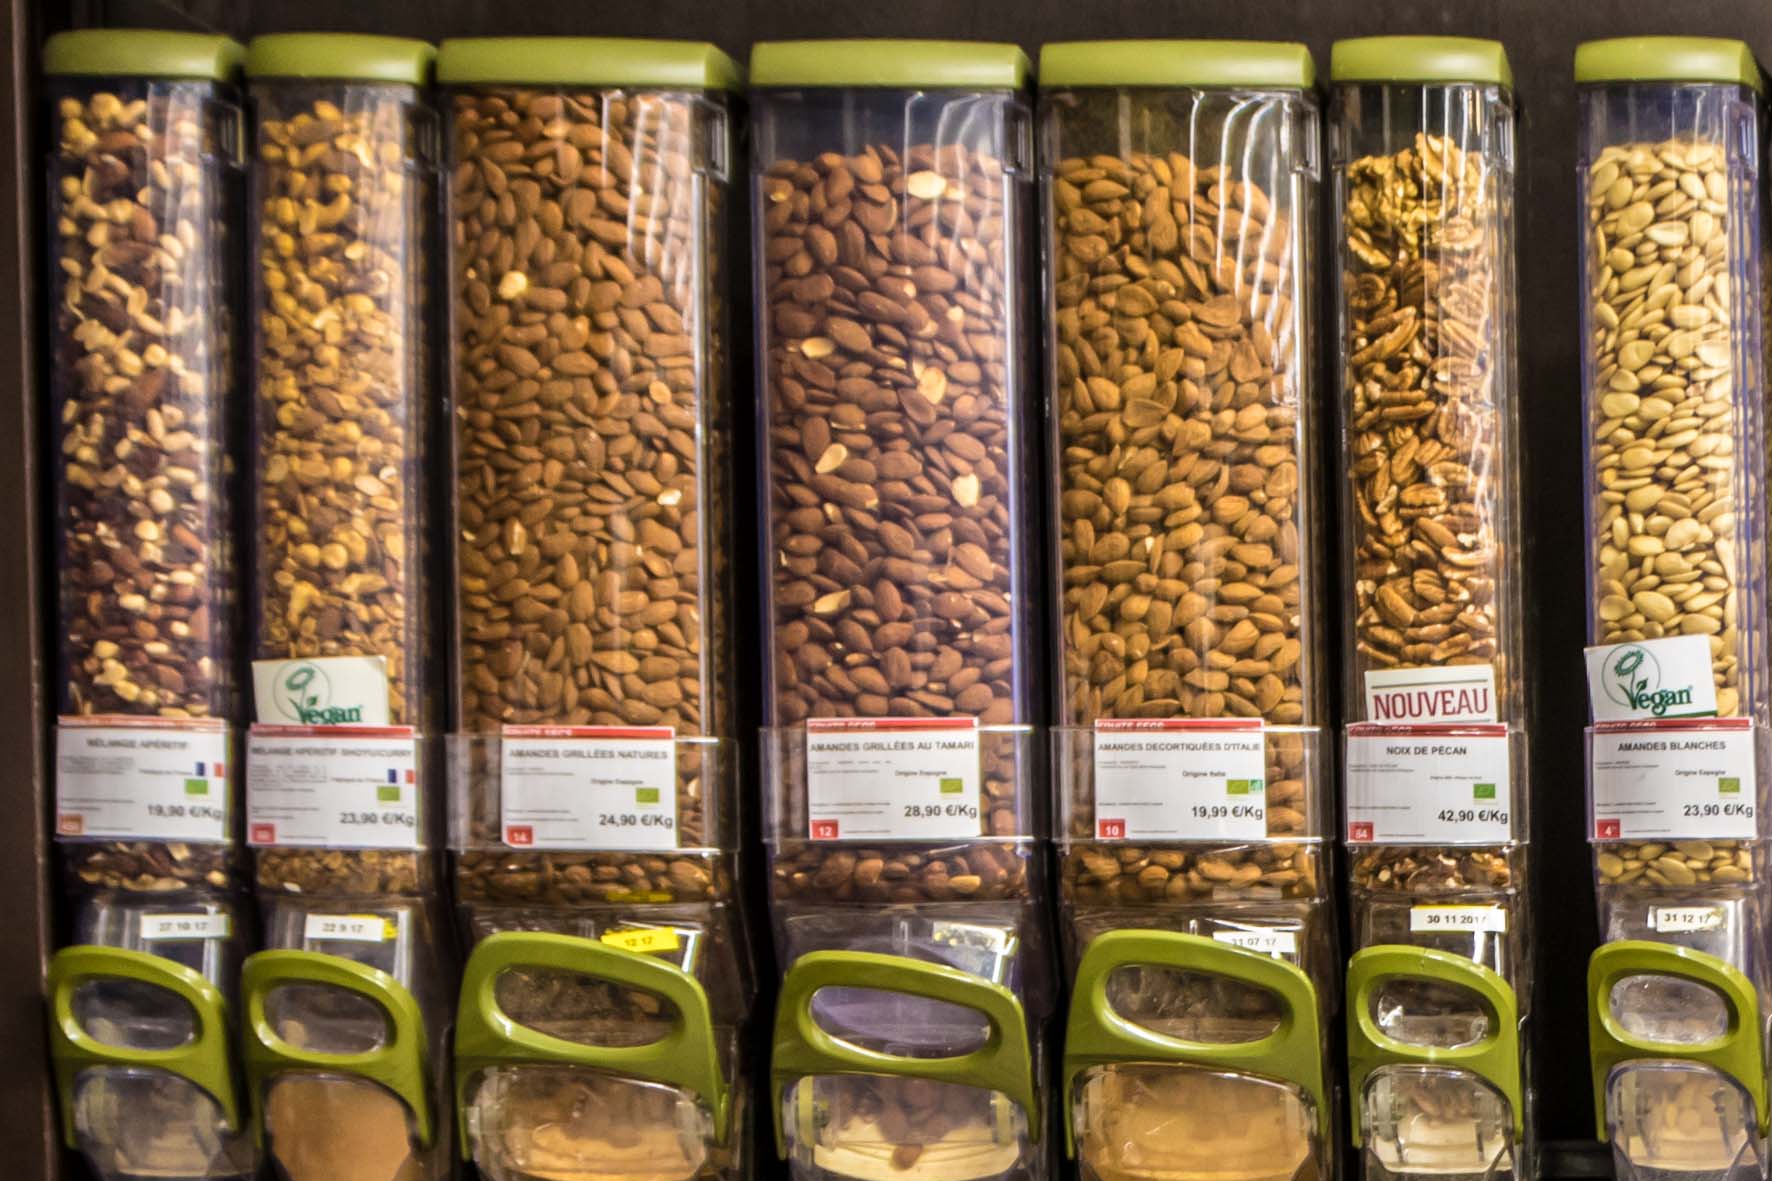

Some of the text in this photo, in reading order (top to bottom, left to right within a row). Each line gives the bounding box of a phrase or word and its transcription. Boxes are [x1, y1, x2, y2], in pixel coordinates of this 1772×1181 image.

[1373, 688, 1489, 720] NOUVEAU
[1618, 682, 1692, 716] Vegan
[809, 742, 860, 753] AMANDES
[916, 741, 933, 751] AU
[935, 741, 975, 752] TAMARI
[1097, 742, 1144, 753] AMANDES
[1386, 745, 1411, 756] NOIX
[1413, 745, 1429, 756] DE
[1617, 740, 1727, 752] AMANDES BLANCHES
[509, 749, 560, 759] AMANDES
[617, 750, 668, 760] NATURES
[904, 804, 977, 819] 28,90 €/Kg
[1191, 805, 1263, 820] 19,99 €/Kg
[1437, 809, 1508, 825] 42,90 €/Kg
[1682, 803, 1753, 818] 23,90 €/Kg
[339, 812, 415, 826] 23,90 €/Kg
[598, 813, 673, 828] 24,90 €/Kg
[819, 826, 832, 837] 12
[1665, 913, 1677, 922] 31
[1683, 914, 1693, 923] 12
